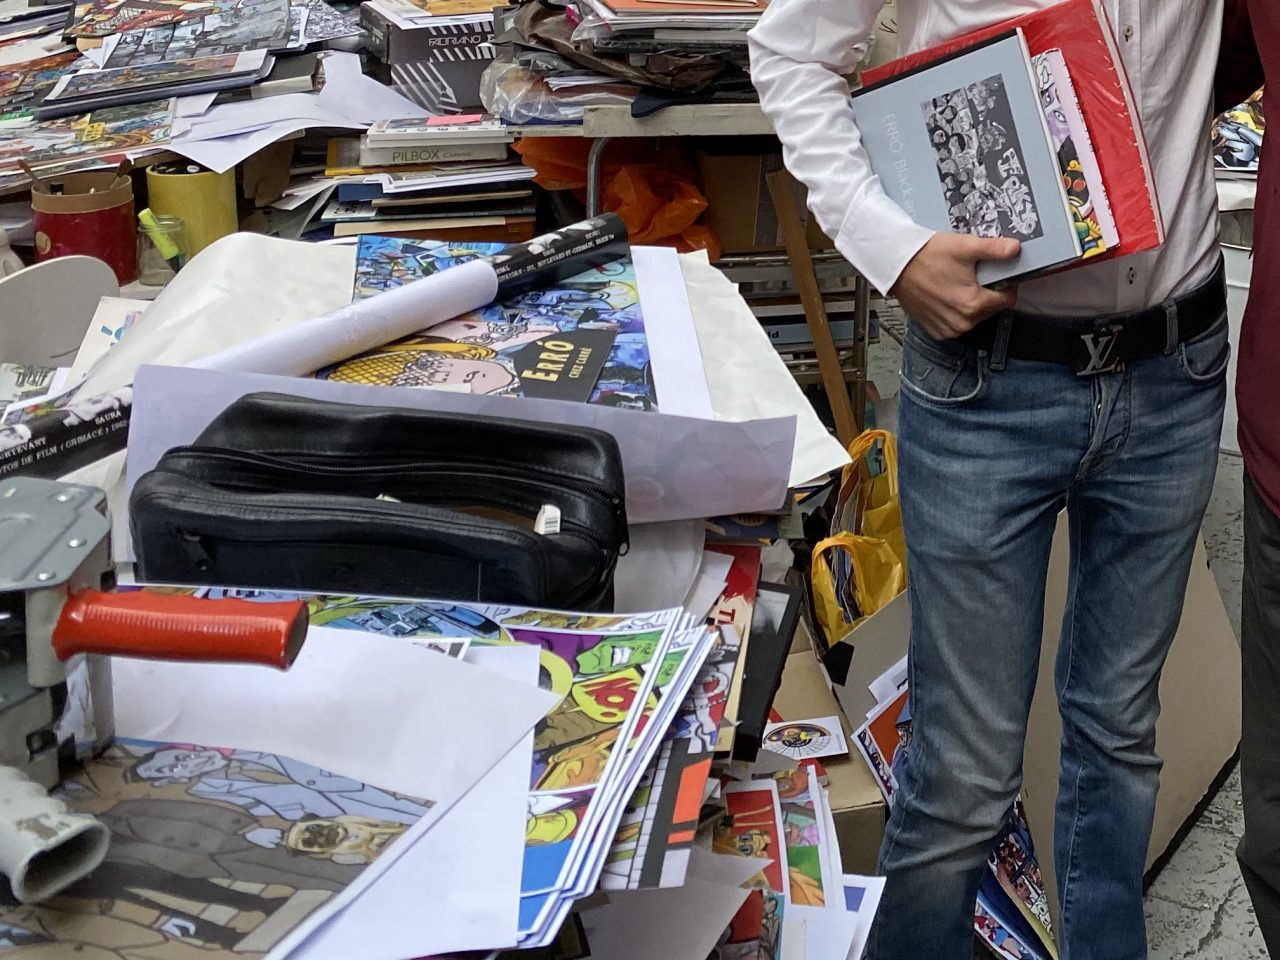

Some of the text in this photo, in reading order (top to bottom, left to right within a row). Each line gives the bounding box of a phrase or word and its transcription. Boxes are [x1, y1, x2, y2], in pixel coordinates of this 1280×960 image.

[428, 35, 481, 46] FABRIANO
[392, 149, 440, 162] PILBOX
[894, 157, 915, 196] Black
[521, 340, 574, 382] ERRÓ
[568, 364, 584, 379] CHEZ
[95, 409, 122, 425] SAURA
[21, 454, 34, 466] DE
[36, 444, 58, 460] FILM
